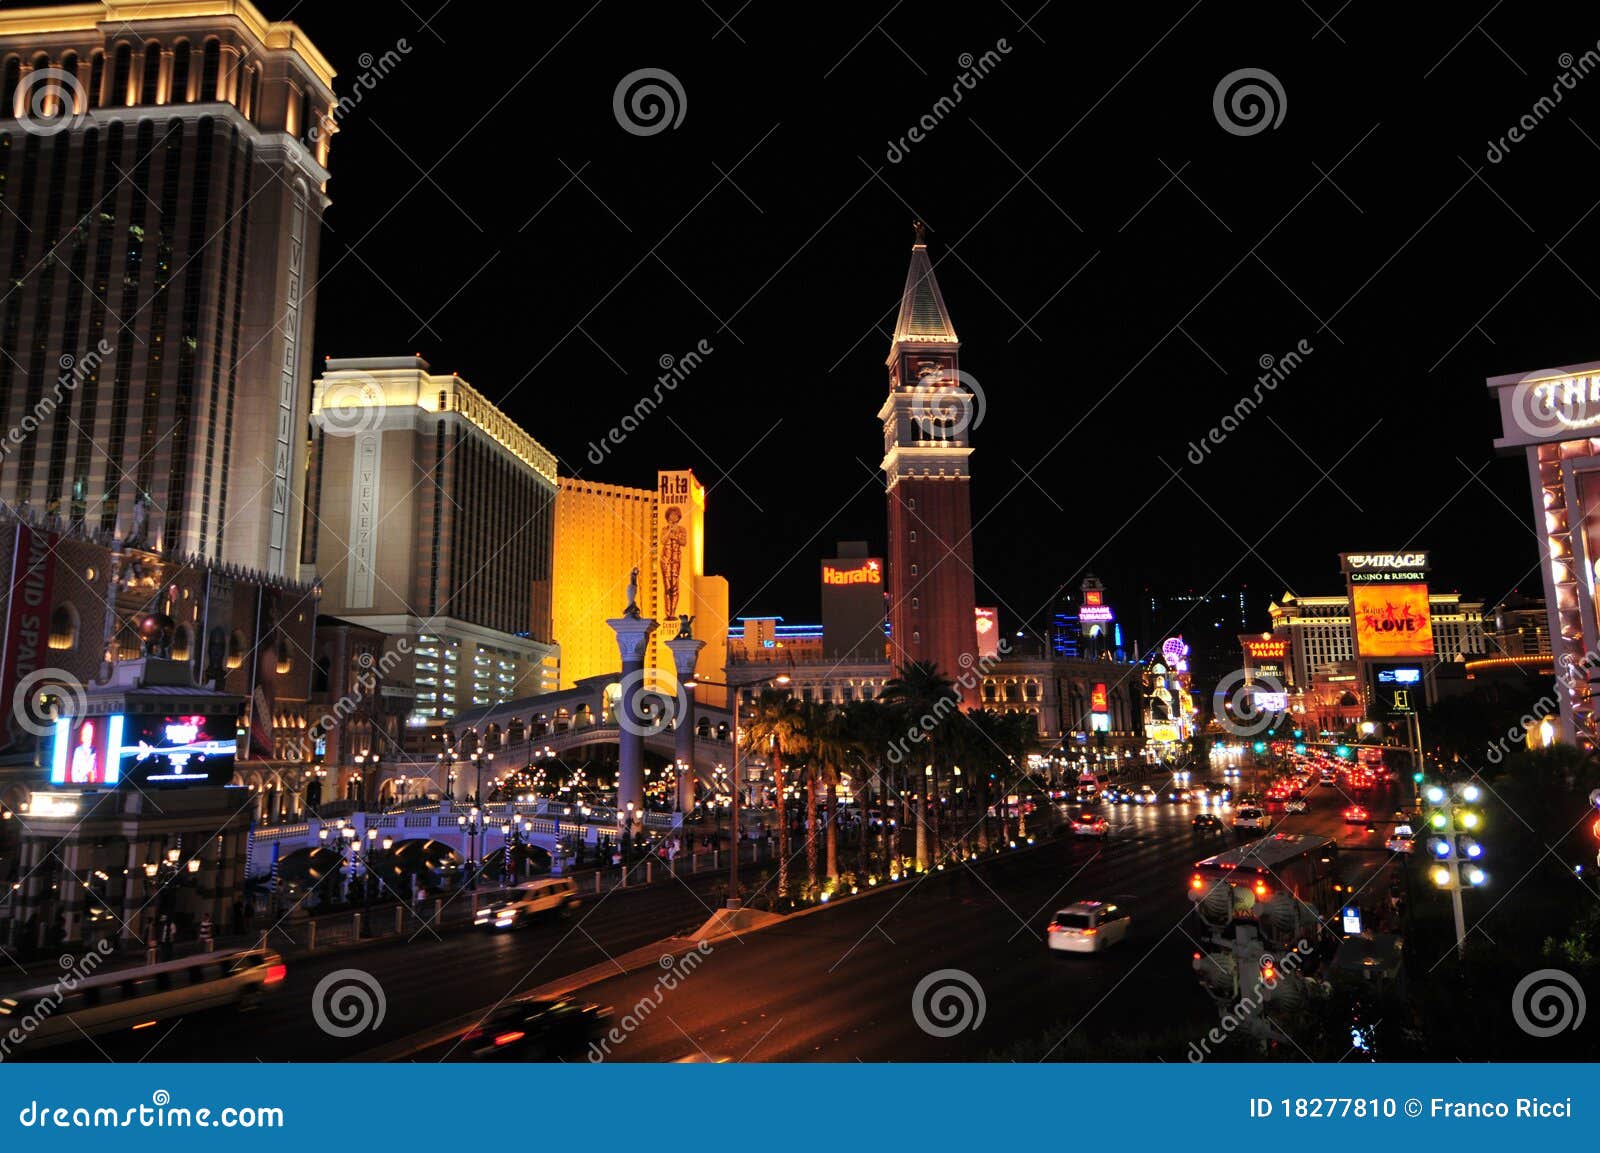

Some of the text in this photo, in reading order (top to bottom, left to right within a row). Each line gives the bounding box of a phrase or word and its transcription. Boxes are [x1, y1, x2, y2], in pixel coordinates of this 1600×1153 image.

[274, 243, 301, 507] VENETIAN
[661, 475, 688, 494] Rita
[358, 472, 372, 573] VENEZIA
[23, 533, 51, 607] DAVID
[1360, 554, 1425, 568] MIRAGE
[1352, 573, 1383, 581] CASINO
[1392, 572, 1425, 580] RESORT
[1374, 618, 1415, 632] LOVE
[1250, 642, 1286, 650] CAESARS
[1393, 690, 1408, 708] JET
